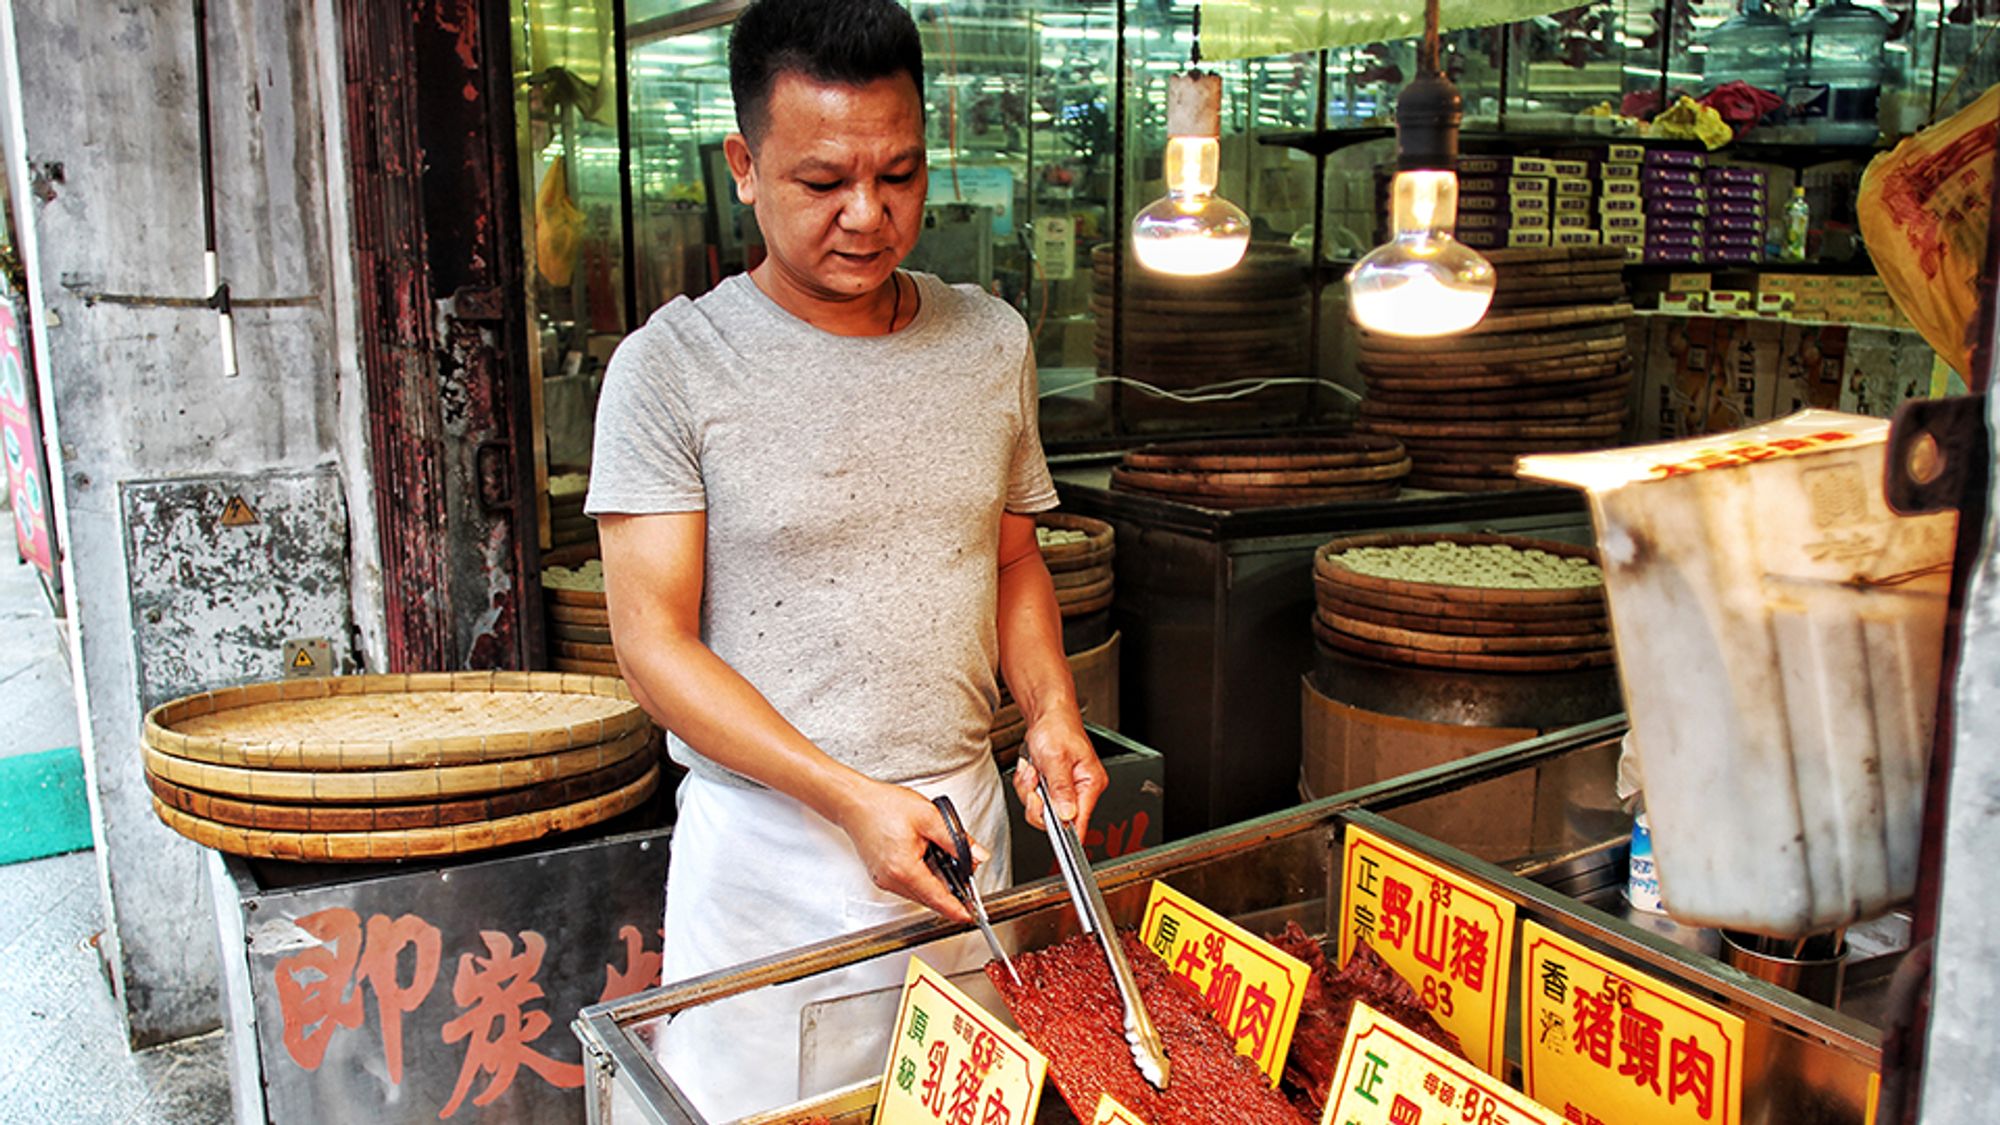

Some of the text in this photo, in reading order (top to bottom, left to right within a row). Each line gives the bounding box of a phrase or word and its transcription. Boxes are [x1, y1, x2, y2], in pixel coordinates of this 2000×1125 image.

[1354, 854, 1380, 944] 正宗
[1378, 876, 1489, 993] 野山豬
[1429, 880, 1452, 909] 83
[274, 906, 664, 1120] 即炭
[1420, 974, 1454, 1018] 83
[1602, 975, 1633, 1008] 56
[1572, 985, 1715, 1121] 豬頸肉
